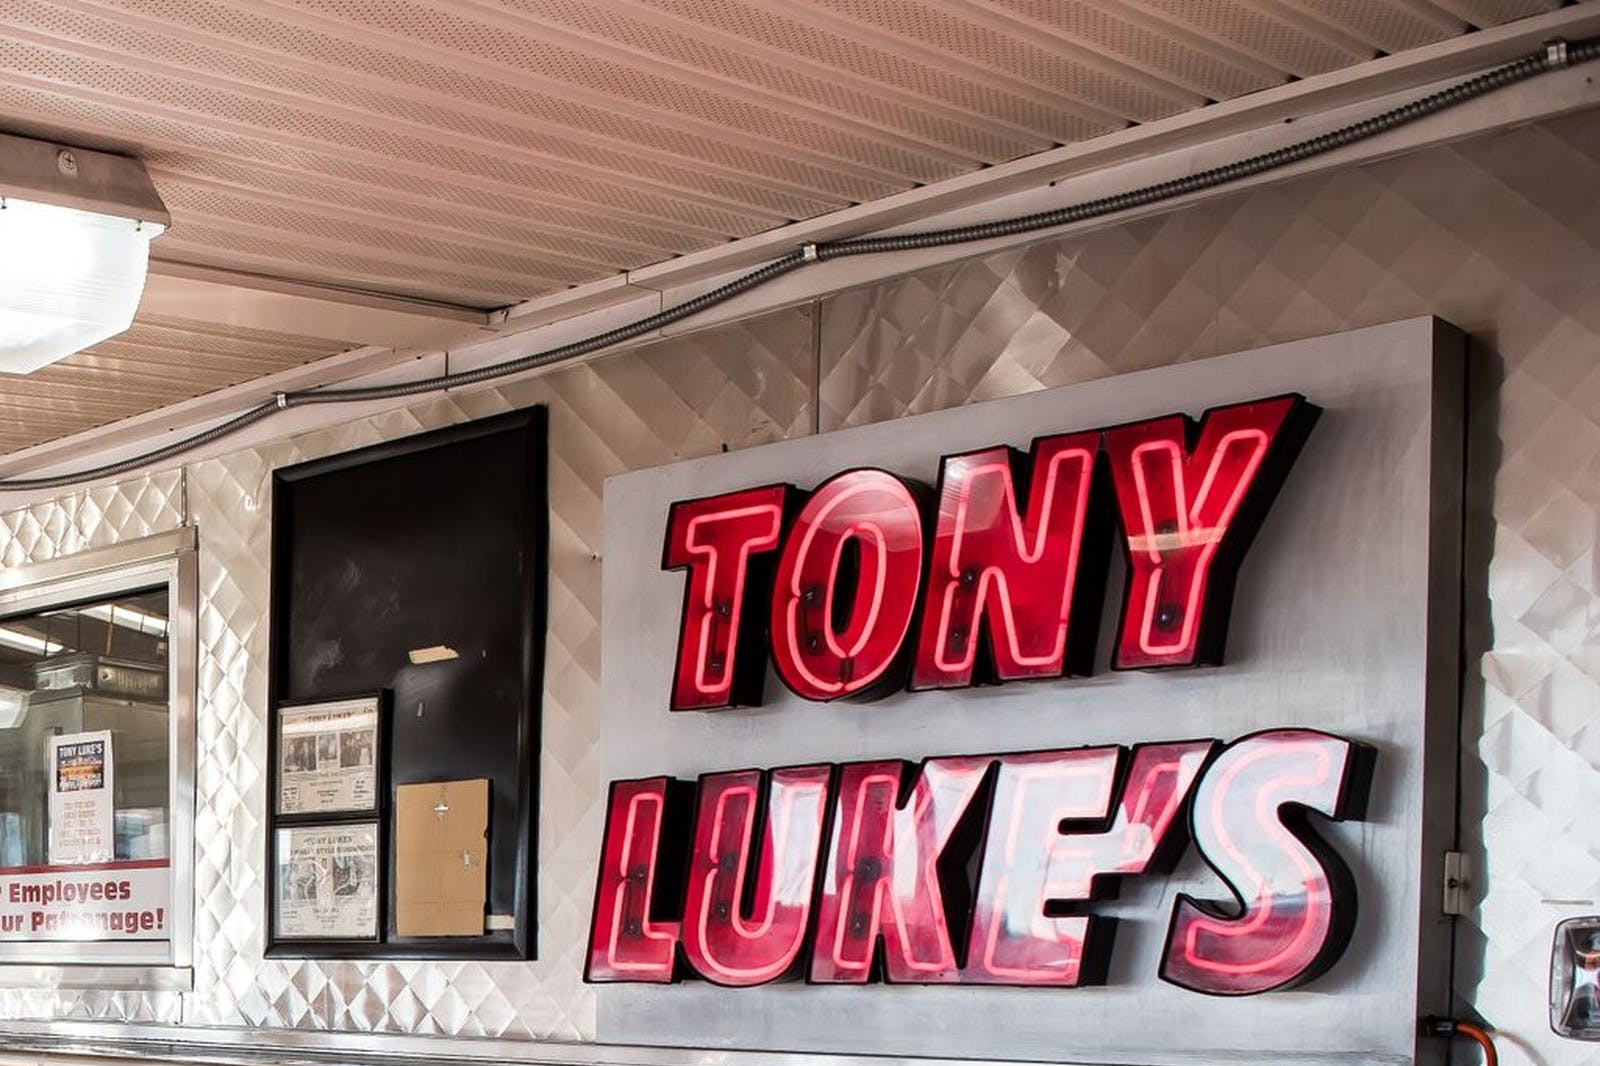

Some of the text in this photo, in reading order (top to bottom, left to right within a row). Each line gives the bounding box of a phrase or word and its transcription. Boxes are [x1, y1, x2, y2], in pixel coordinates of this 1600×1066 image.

[660, 392, 1322, 712] TONY
[8, 880, 131, 906] Employees
[31, 908, 165, 934] Patnage!
[583, 727, 1376, 997] LUKE'S
